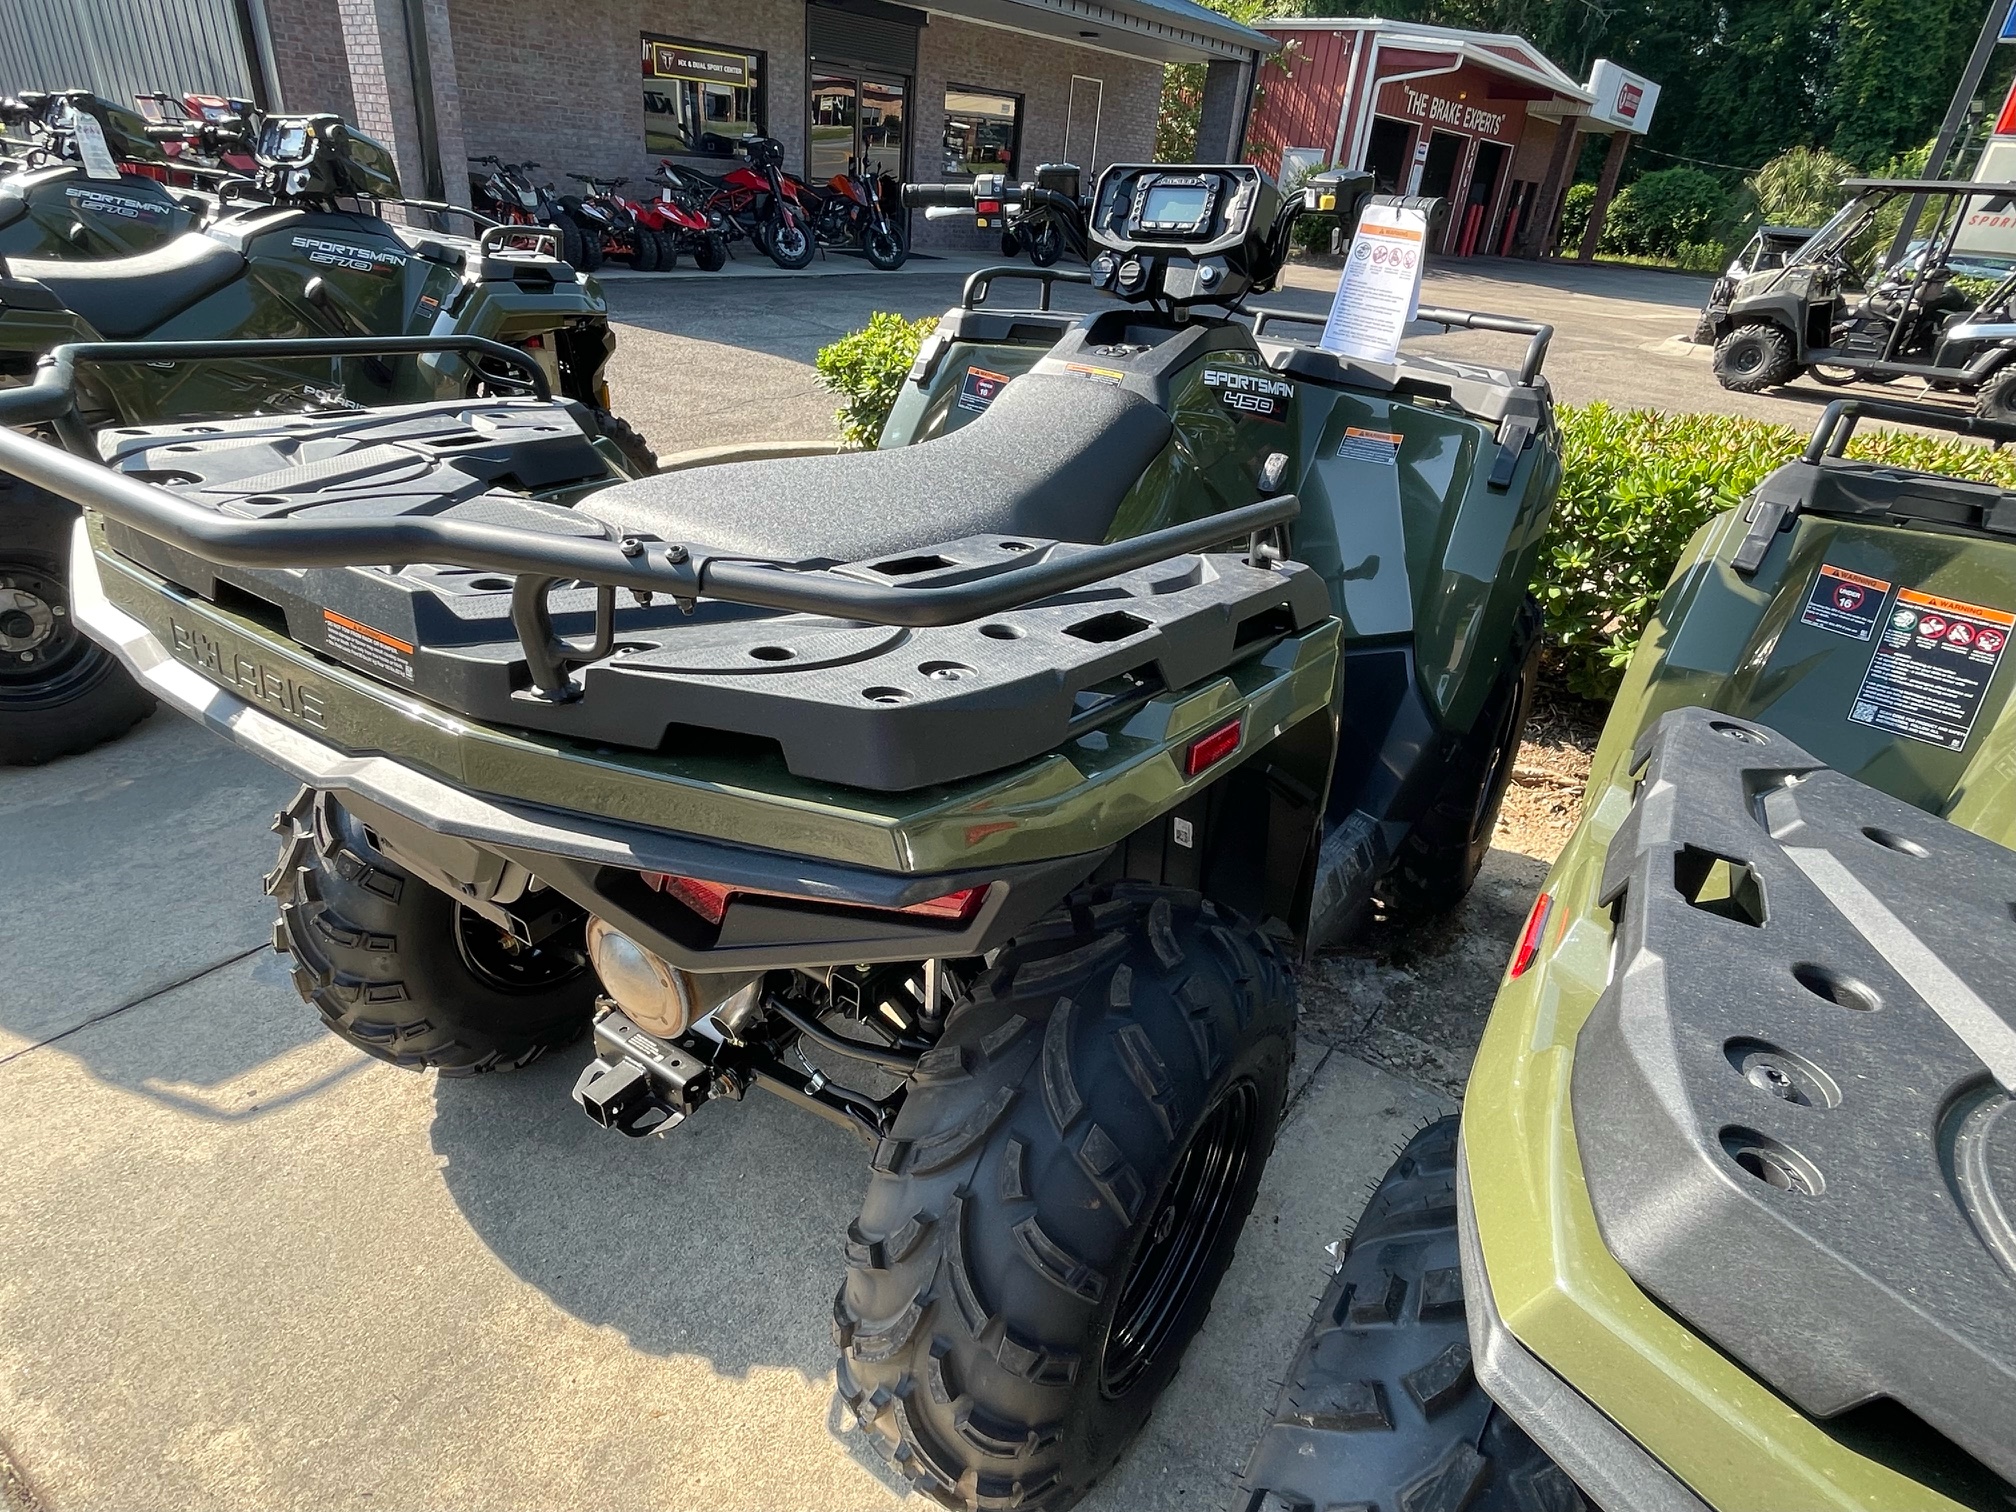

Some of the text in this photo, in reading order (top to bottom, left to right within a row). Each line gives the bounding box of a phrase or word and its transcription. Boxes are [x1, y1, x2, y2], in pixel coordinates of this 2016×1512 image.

[1429, 97, 1463, 126] BRAKE
[65, 188, 170, 215] SPORTSMAN
[81, 200, 139, 218] 570
[291, 236, 407, 267] SPORTSMAN
[309, 251, 373, 272] 570
[1203, 370, 1295, 399] SPORTSMAN
[1223, 391, 1274, 414] 450
[1841, 570, 1877, 587] WARNING
[1839, 588, 1861, 599] UNDER
[1839, 597, 1853, 609] 16
[1940, 600, 1983, 616] WARNING
[170, 617, 329, 731] POLARIS
